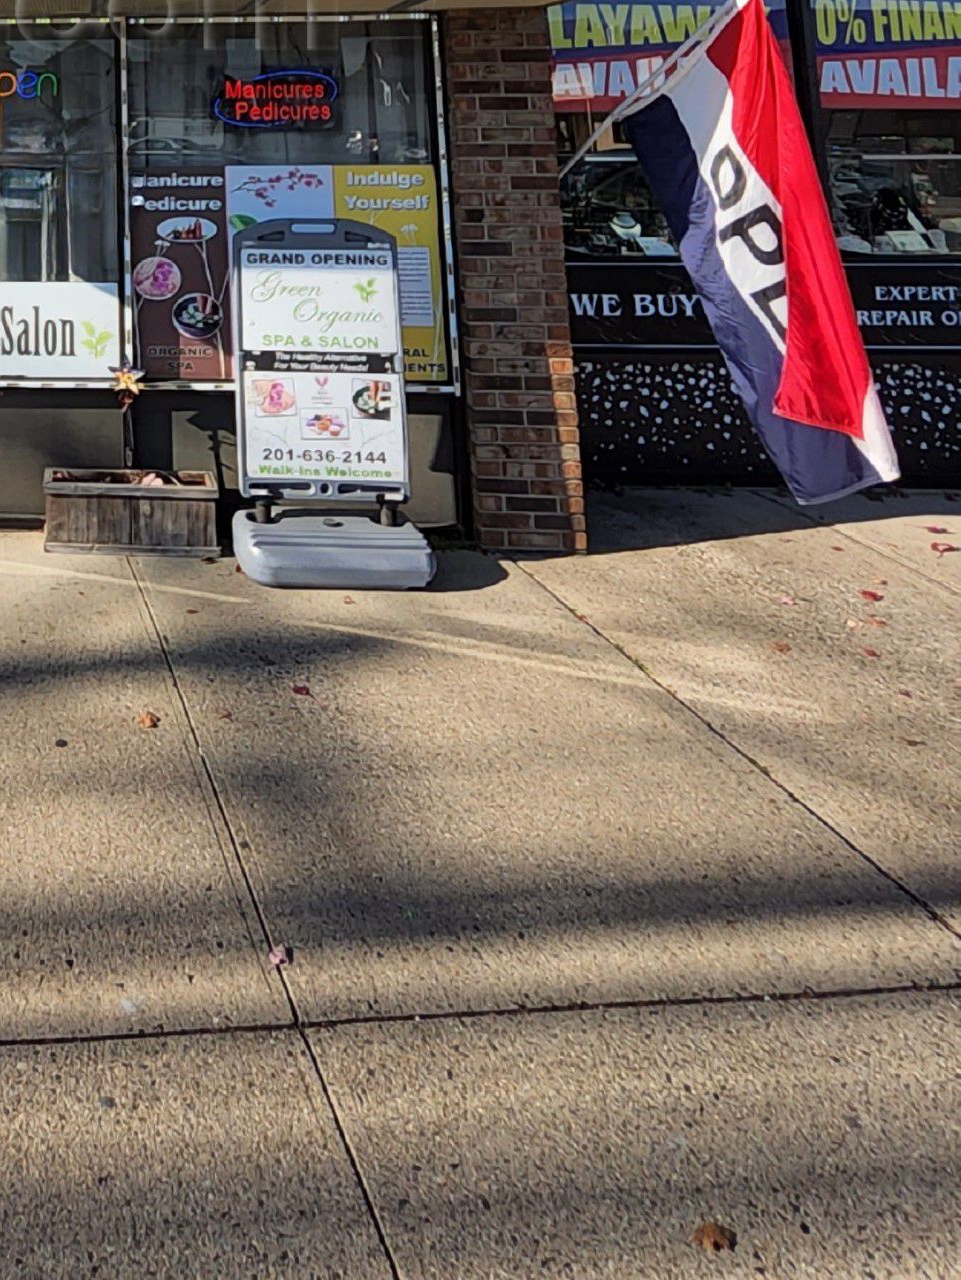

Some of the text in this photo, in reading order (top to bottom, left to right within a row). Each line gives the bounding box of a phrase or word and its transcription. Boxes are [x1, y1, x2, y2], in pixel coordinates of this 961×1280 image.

[225, 80, 324, 100] Manicures
[235, 101, 331, 121] Pedicures
[345, 170, 424, 188] Indulge
[344, 194, 431, 210] Yourself
[246, 252, 389, 266] GRAND OPENING
[251, 270, 324, 303] Green
[875, 285, 958, 301] EXPERT
[572, 294, 702, 317] WE BUY
[293, 298, 383, 333] Organic
[856, 310, 961, 327] REPAIR O
[0, 305, 76, 357] Salon
[262, 334, 379, 349] SPA & SALON
[148, 346, 213, 357] ORGANIC
[167, 361, 193, 371] SPA
[263, 448, 387, 464] 201-636-2144
[325, 466, 392, 478] Welcome
